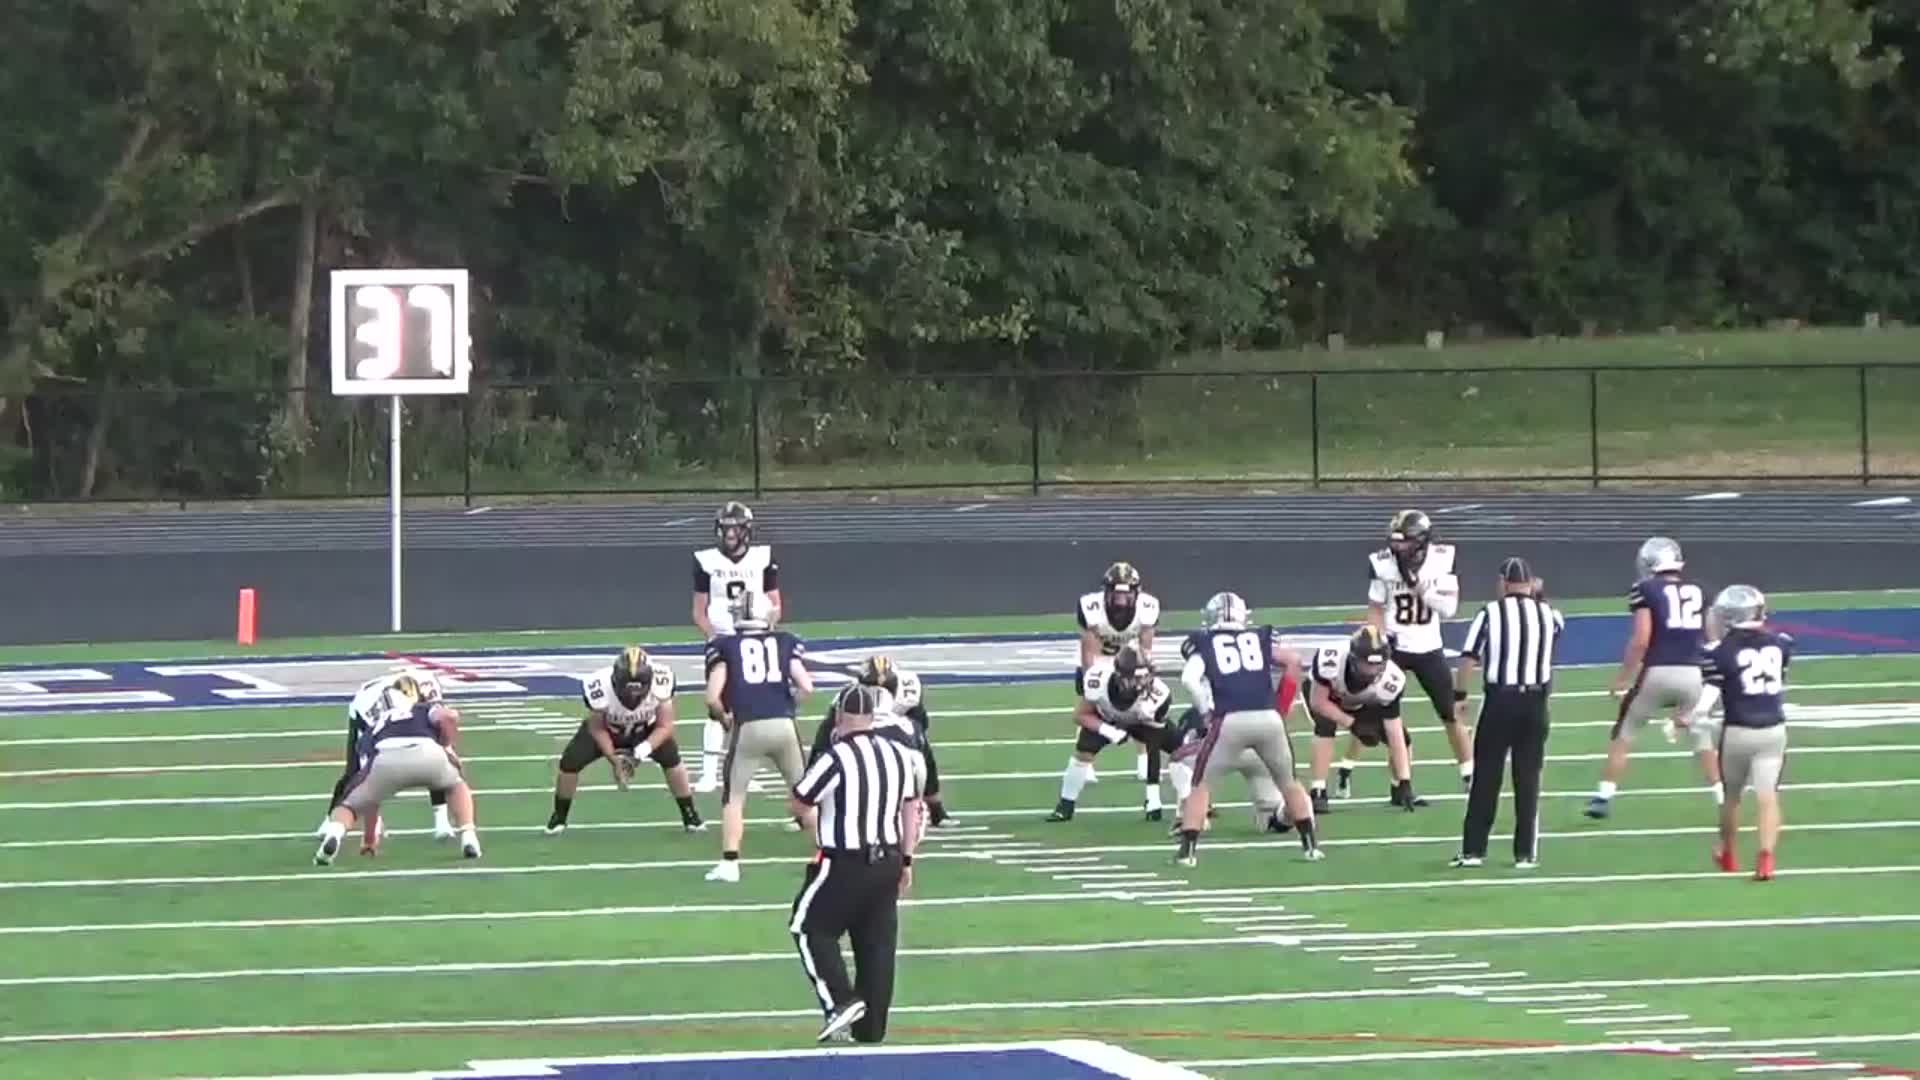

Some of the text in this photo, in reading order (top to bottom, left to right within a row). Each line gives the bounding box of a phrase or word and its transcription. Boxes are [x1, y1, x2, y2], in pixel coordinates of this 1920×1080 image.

[355, 284, 452, 379] 37
[1394, 593, 1433, 625] 80
[1663, 584, 1702, 629] 12
[740, 636, 782, 684] 81
[1213, 632, 1264, 675] 68
[1736, 645, 1783, 695] 29
[588, 679, 604, 700] 58
